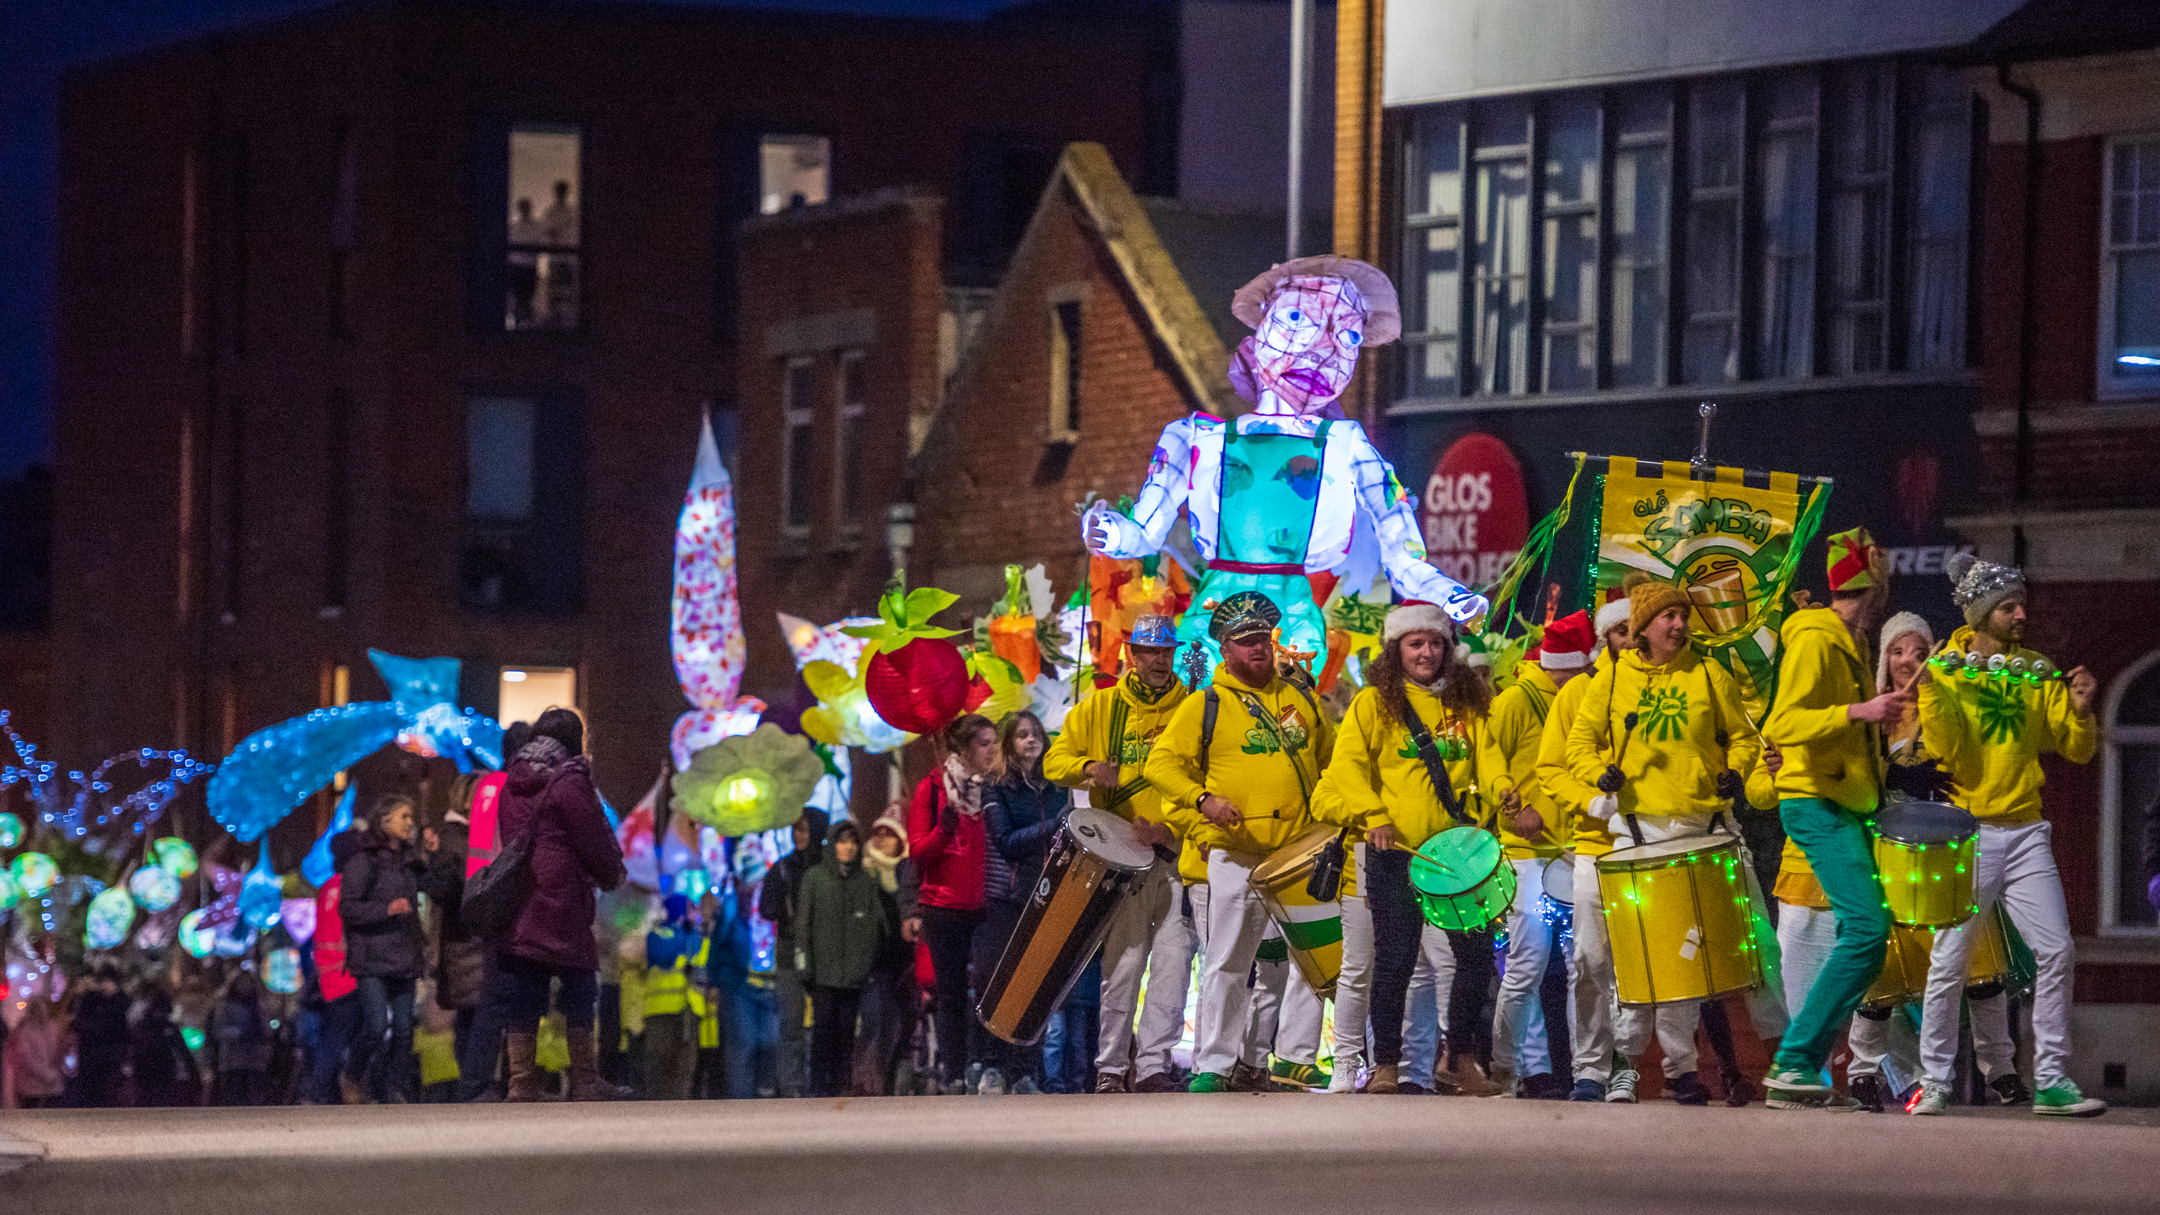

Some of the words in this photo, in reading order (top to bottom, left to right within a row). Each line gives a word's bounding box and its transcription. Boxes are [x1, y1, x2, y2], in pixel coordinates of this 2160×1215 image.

[1427, 472, 1492, 512] GLOS
[1426, 513, 1478, 551] BIKE
[1644, 497, 1772, 555] SAMBA
